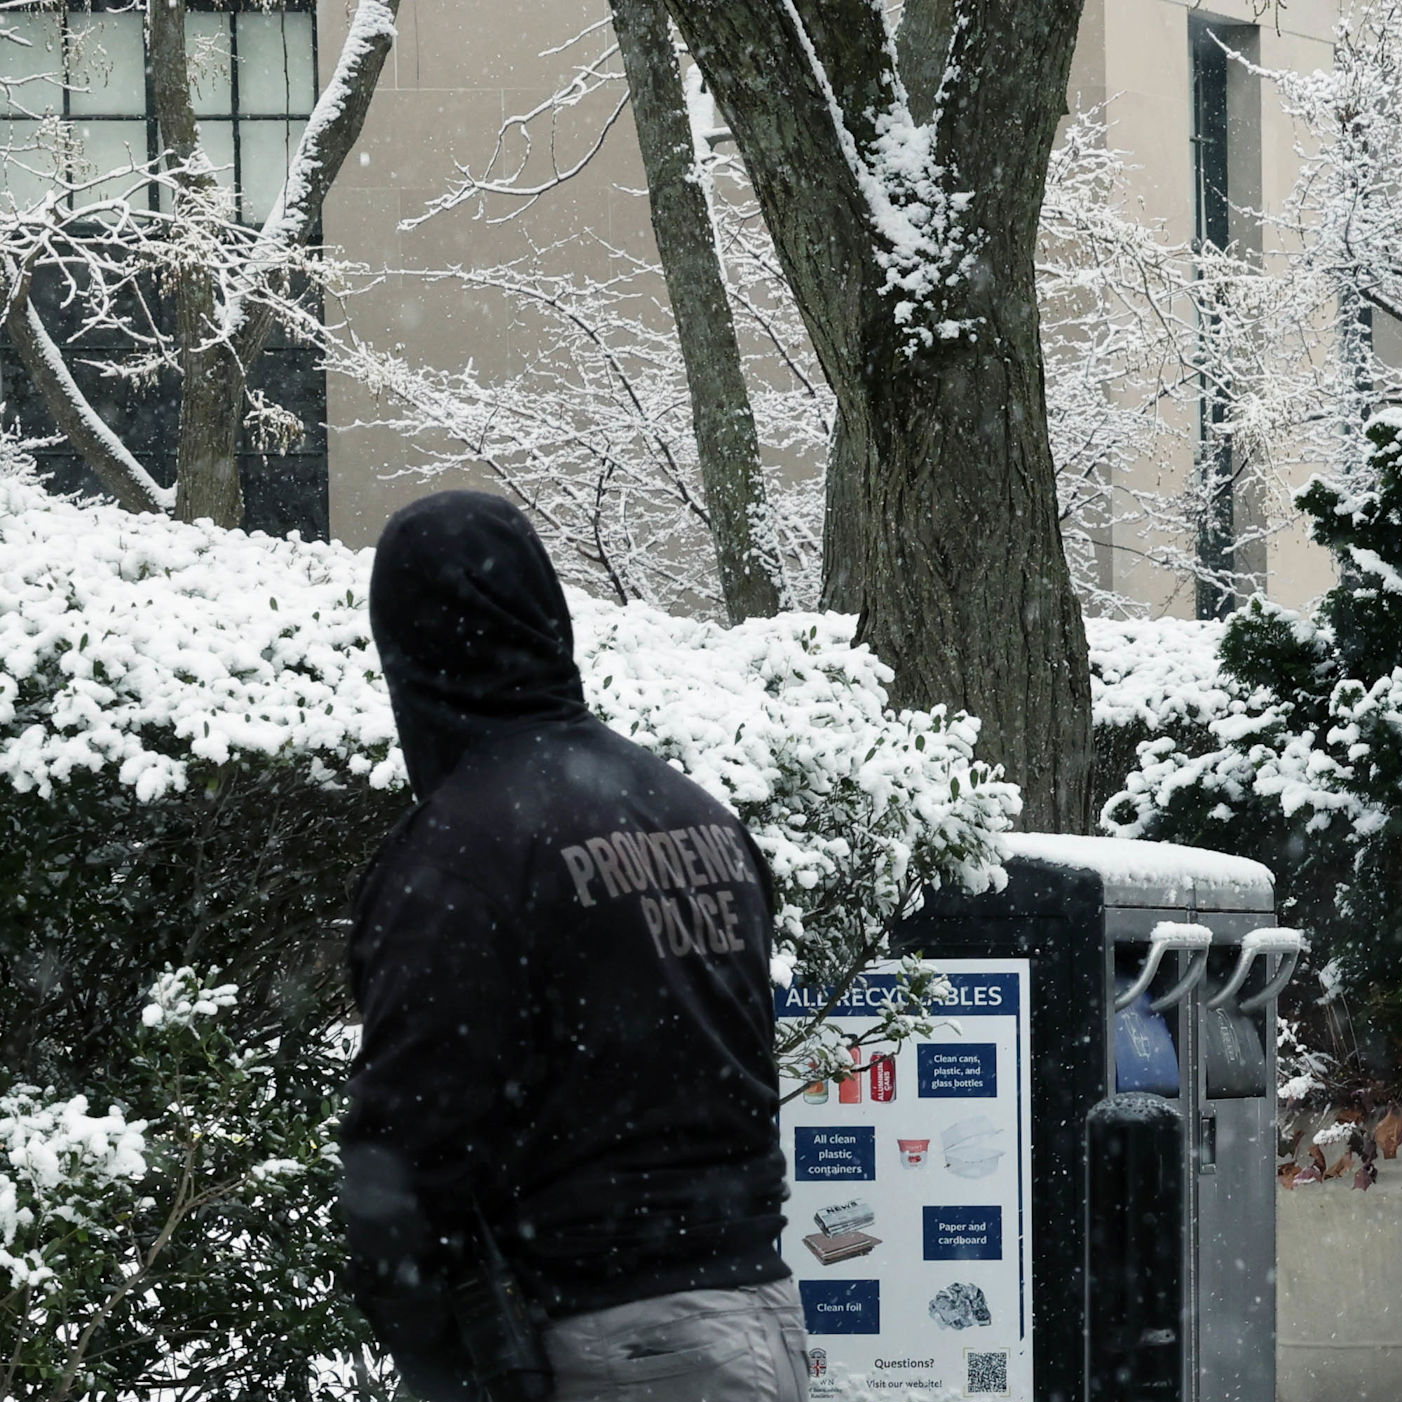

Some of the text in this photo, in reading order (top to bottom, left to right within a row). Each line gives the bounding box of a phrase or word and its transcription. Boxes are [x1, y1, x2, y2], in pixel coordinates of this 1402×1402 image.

[838, 986, 1003, 1007] RECYCABLES
[934, 1054, 981, 1065] Clean cans,
[933, 1066, 981, 1076] plastic, and
[931, 1078, 984, 1089] glass bottles
[813, 1134, 857, 1144] All clean
[818, 1149, 853, 1160] plastic
[808, 1164, 863, 1174] containers
[826, 1200, 859, 1214] NEWS
[939, 1222, 987, 1233] Paper and
[938, 1235, 988, 1245] cardboard
[816, 1303, 862, 1312] Clean foil
[874, 1358, 935, 1370] Questions?
[866, 1379, 943, 1389] Visit our website!
